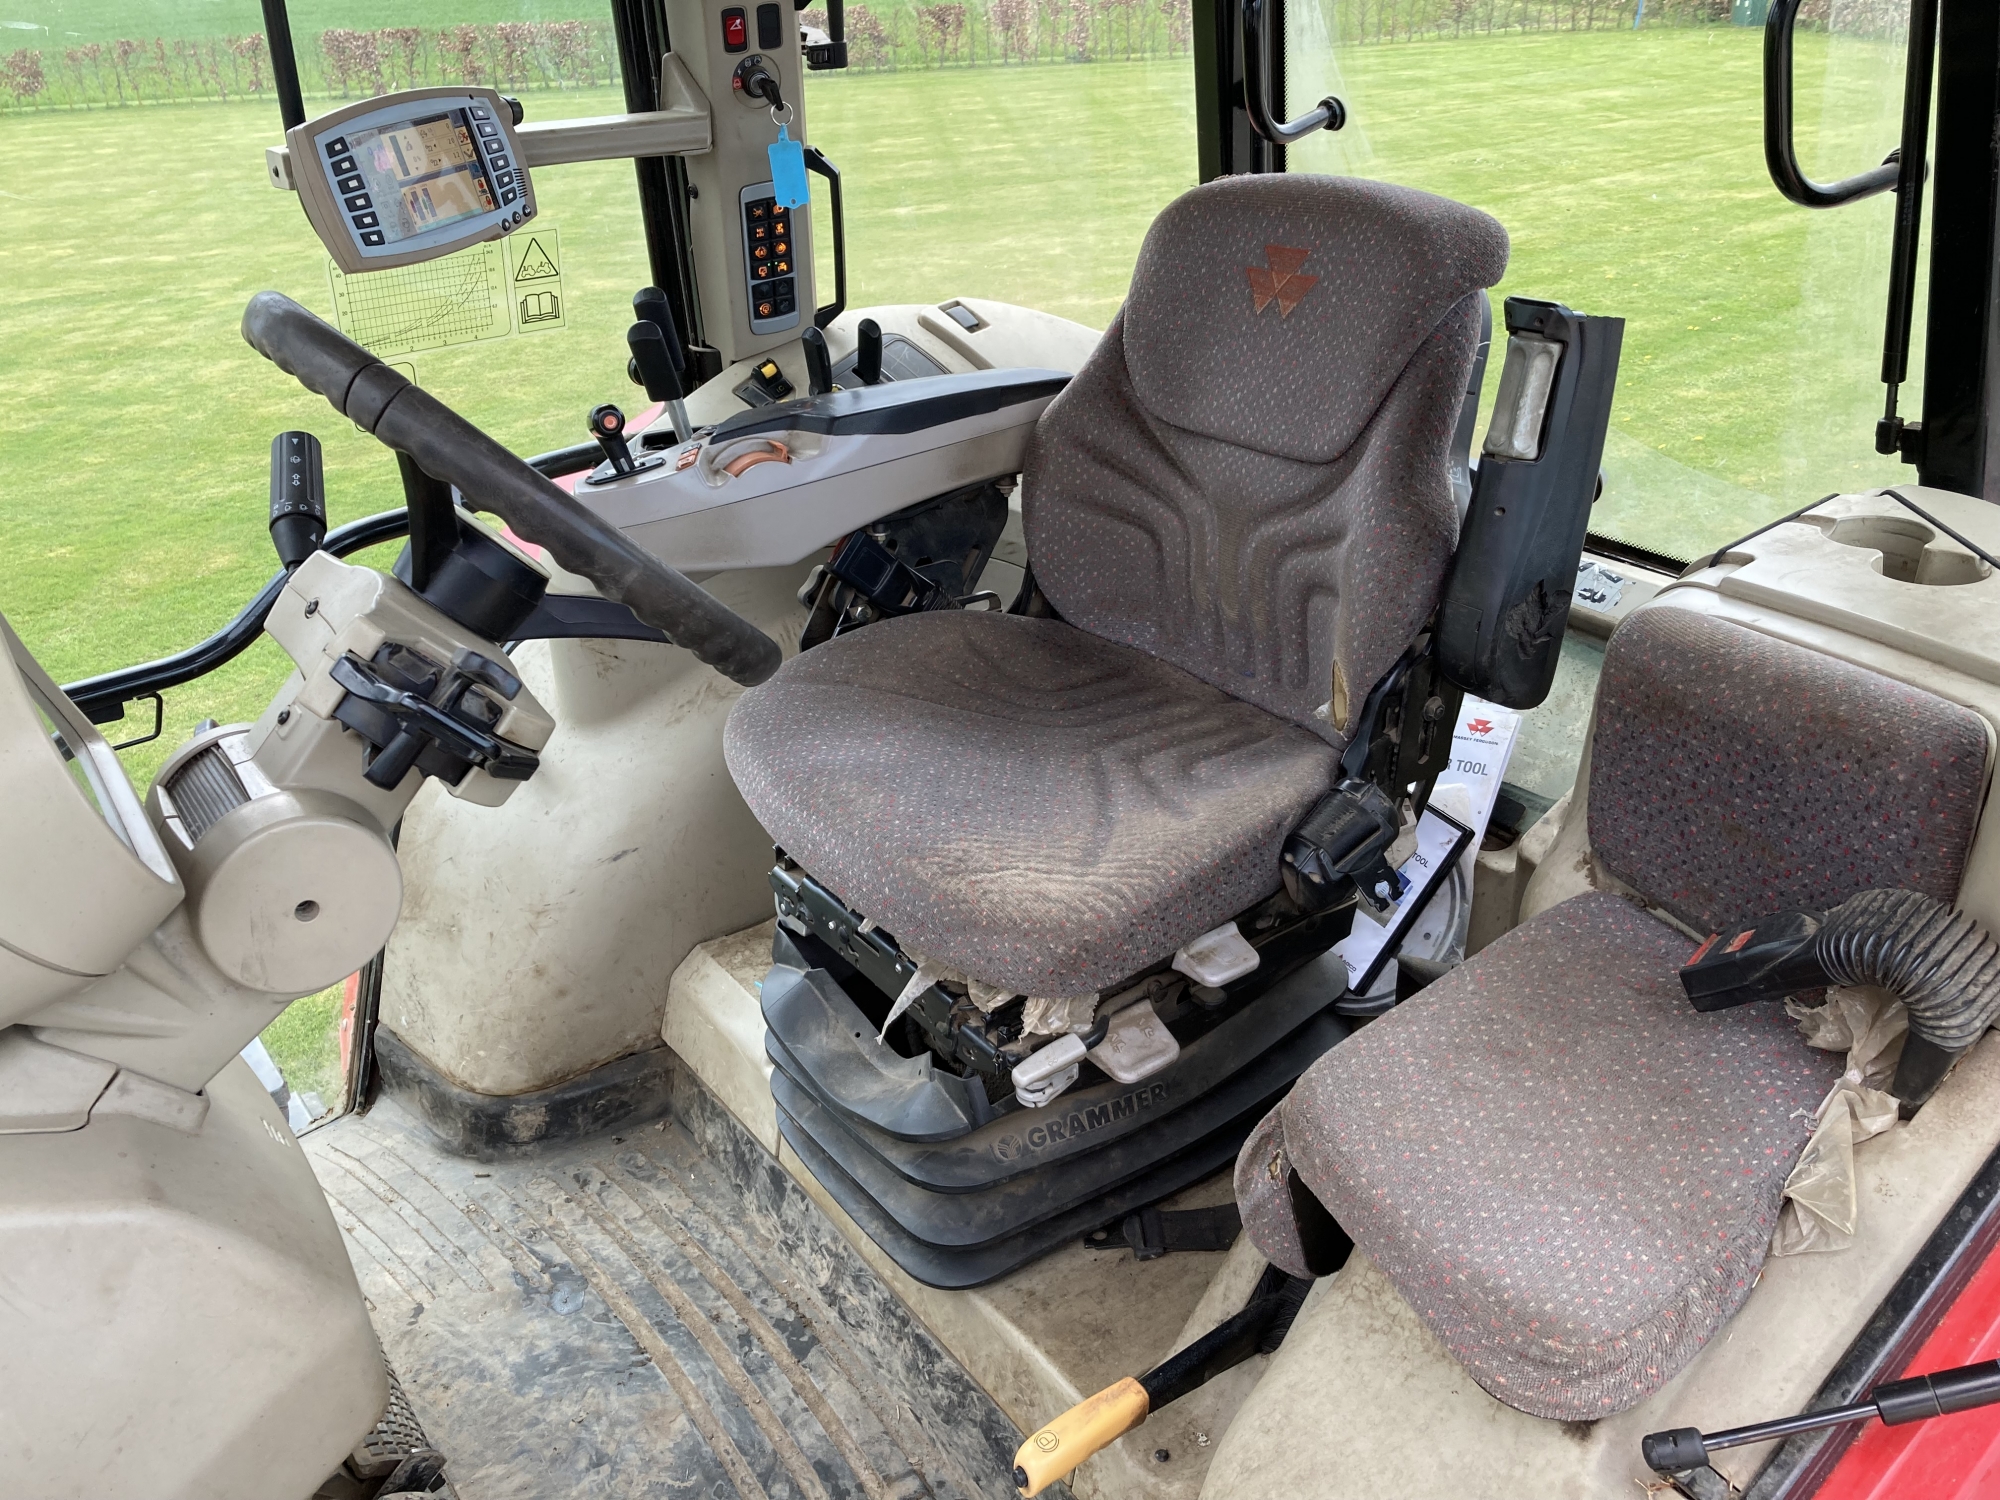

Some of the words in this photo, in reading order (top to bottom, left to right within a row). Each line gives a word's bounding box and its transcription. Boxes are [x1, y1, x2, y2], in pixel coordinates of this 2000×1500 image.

[1456, 759, 1488, 776] TOOL
[1411, 852, 1429, 869] TOOL
[1027, 1082, 1168, 1148] GRAMMER
